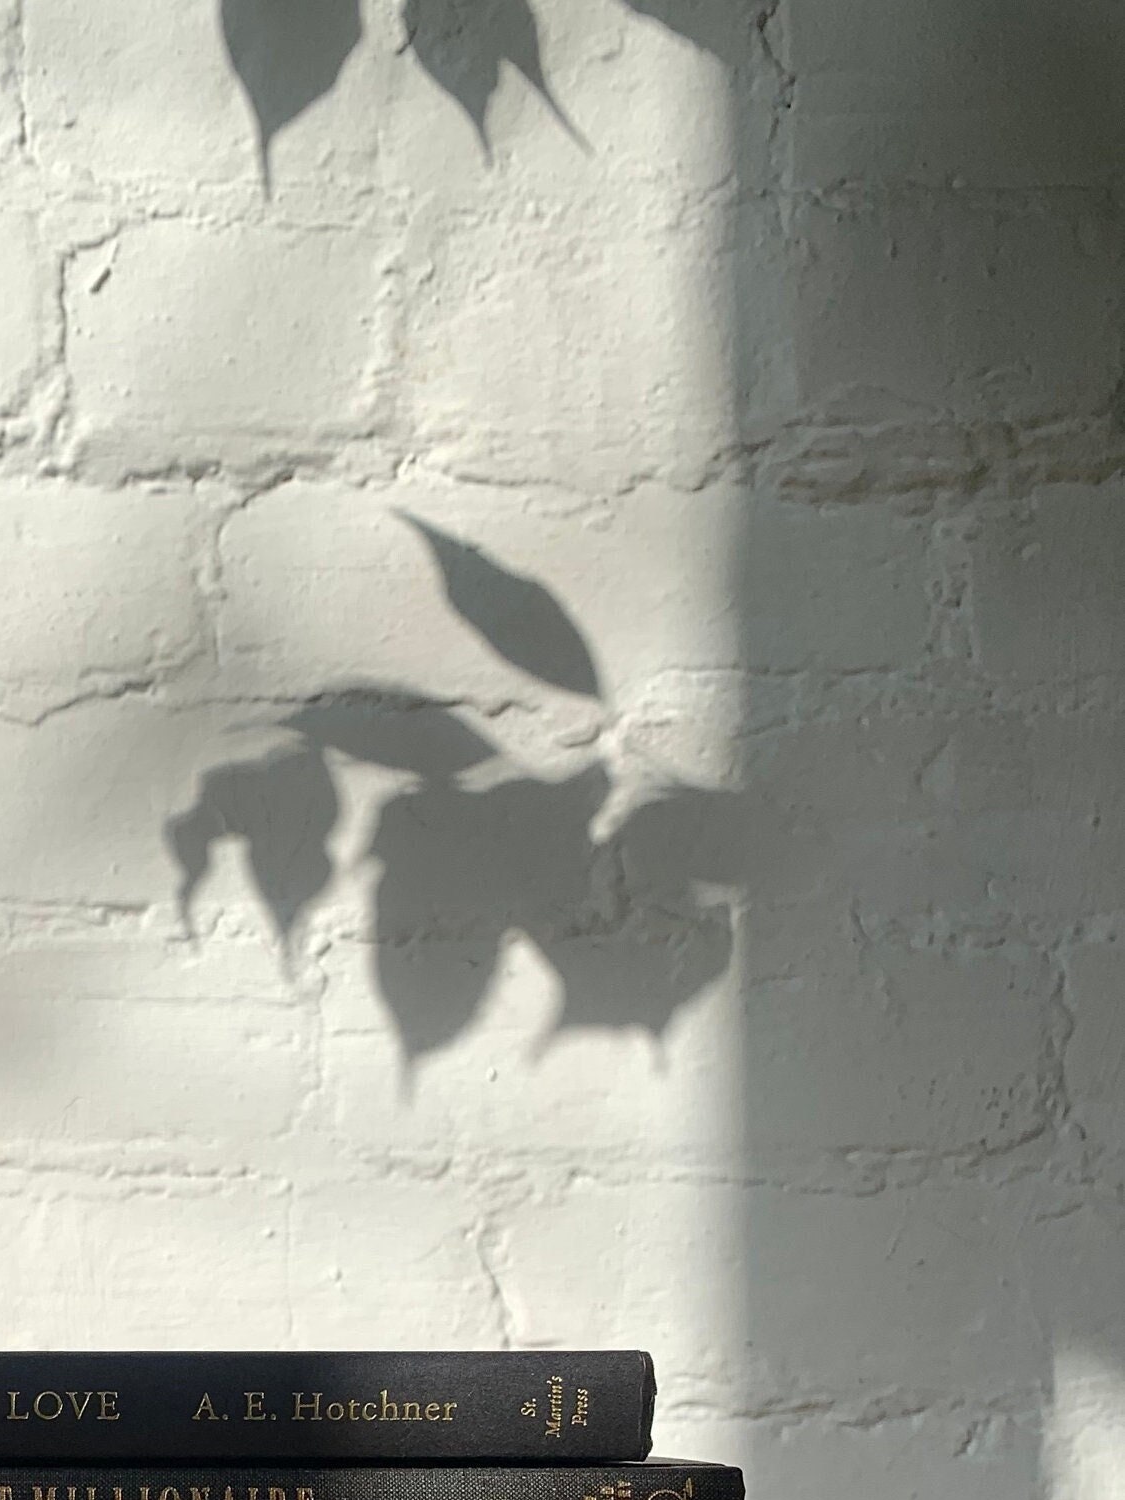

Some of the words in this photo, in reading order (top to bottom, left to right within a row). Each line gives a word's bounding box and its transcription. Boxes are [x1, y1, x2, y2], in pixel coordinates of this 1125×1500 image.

[7, 1391, 121, 1421] LOVE
[190, 1390, 230, 1421] A.
[242, 1391, 278, 1421] E.
[291, 1389, 456, 1423] Hotchner
[520, 1398, 536, 1417] St.
[545, 1376, 562, 1437] Martin's
[571, 1389, 588, 1426] Press
